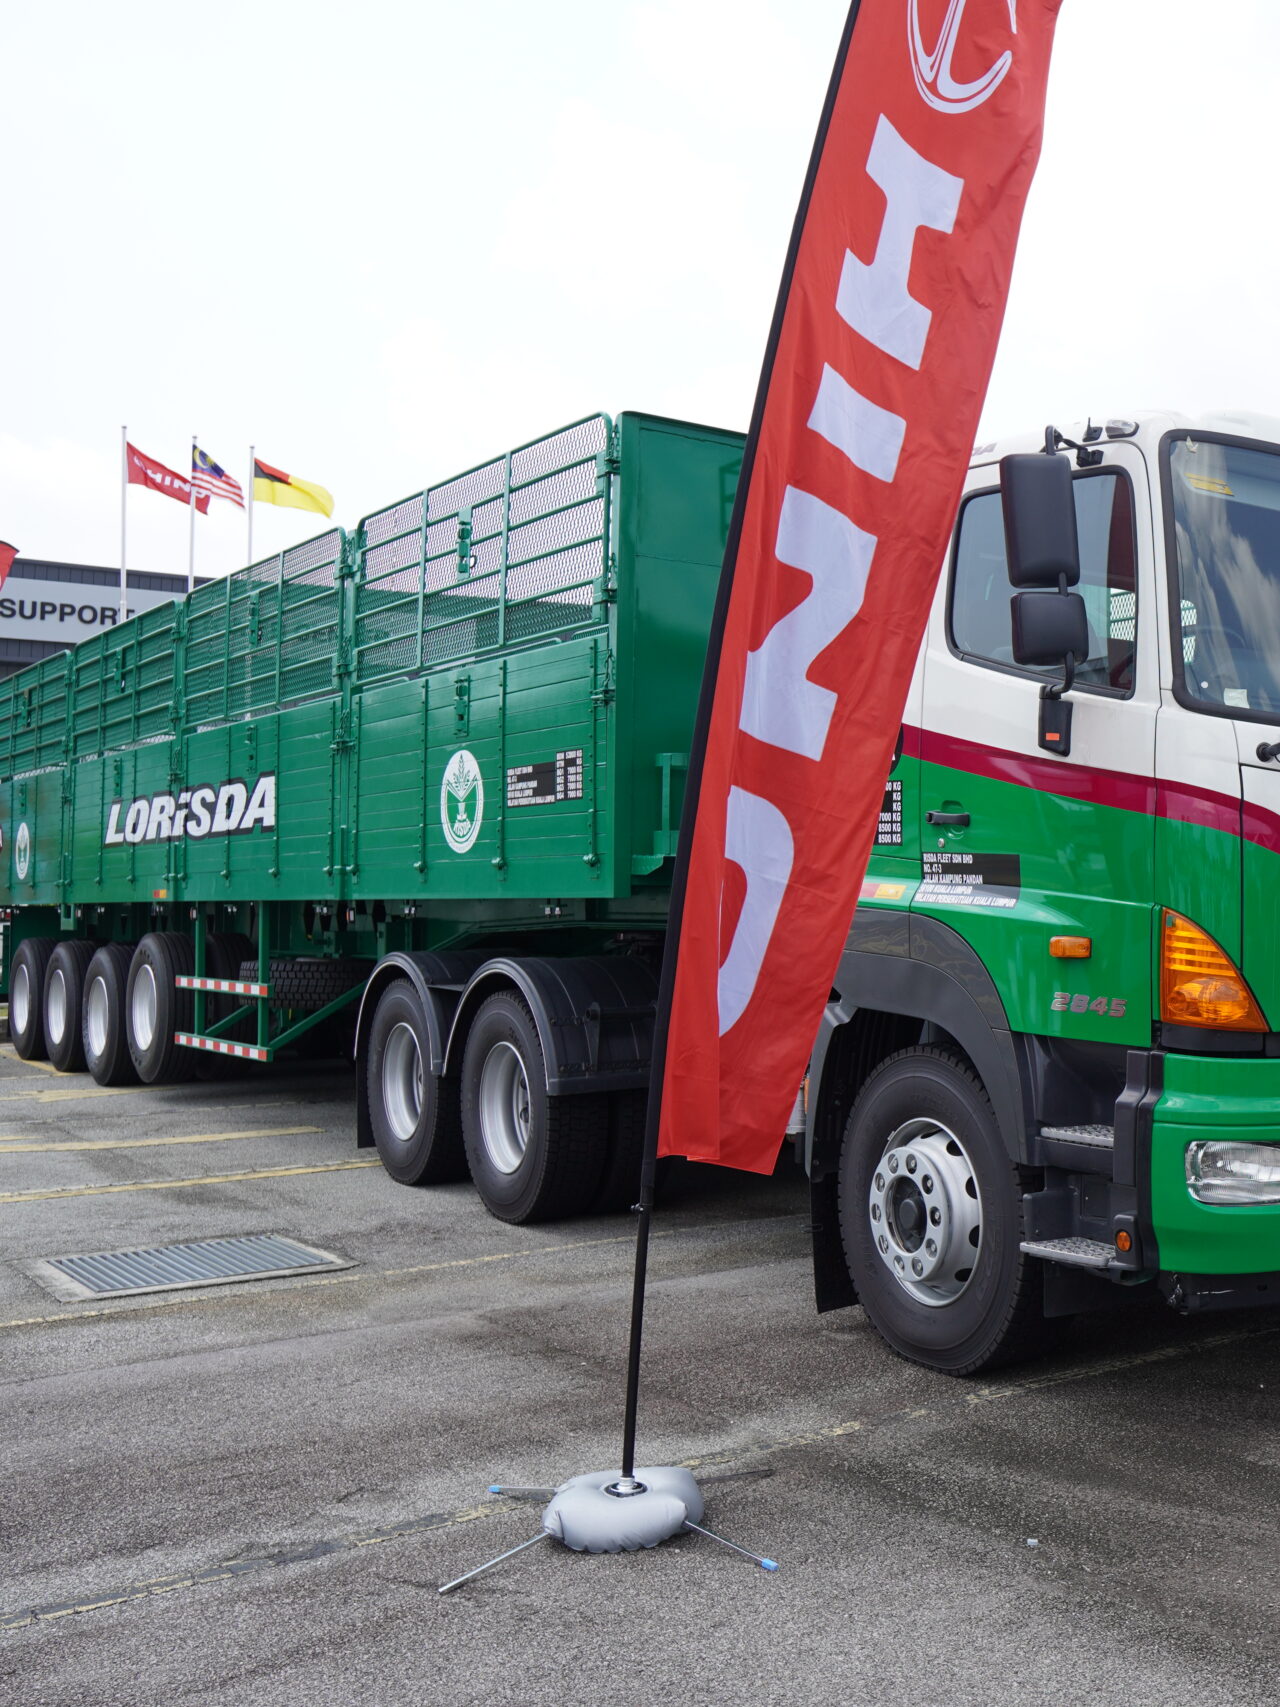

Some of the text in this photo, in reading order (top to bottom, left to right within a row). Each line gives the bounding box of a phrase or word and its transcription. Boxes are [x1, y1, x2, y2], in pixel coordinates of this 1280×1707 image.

[893, 782, 901, 791] KG
[893, 792, 901, 800] KG
[893, 802, 901, 811] KG
[893, 812, 901, 821] KG
[893, 823, 901, 832] KG
[893, 834, 901, 843] KG
[938, 854, 951, 863] FLEET
[952, 854, 962, 863] SDN
[963, 855, 973, 864] BHD
[939, 874, 962, 884] KAMPUNG
[1050, 992, 1128, 1018] 2845
